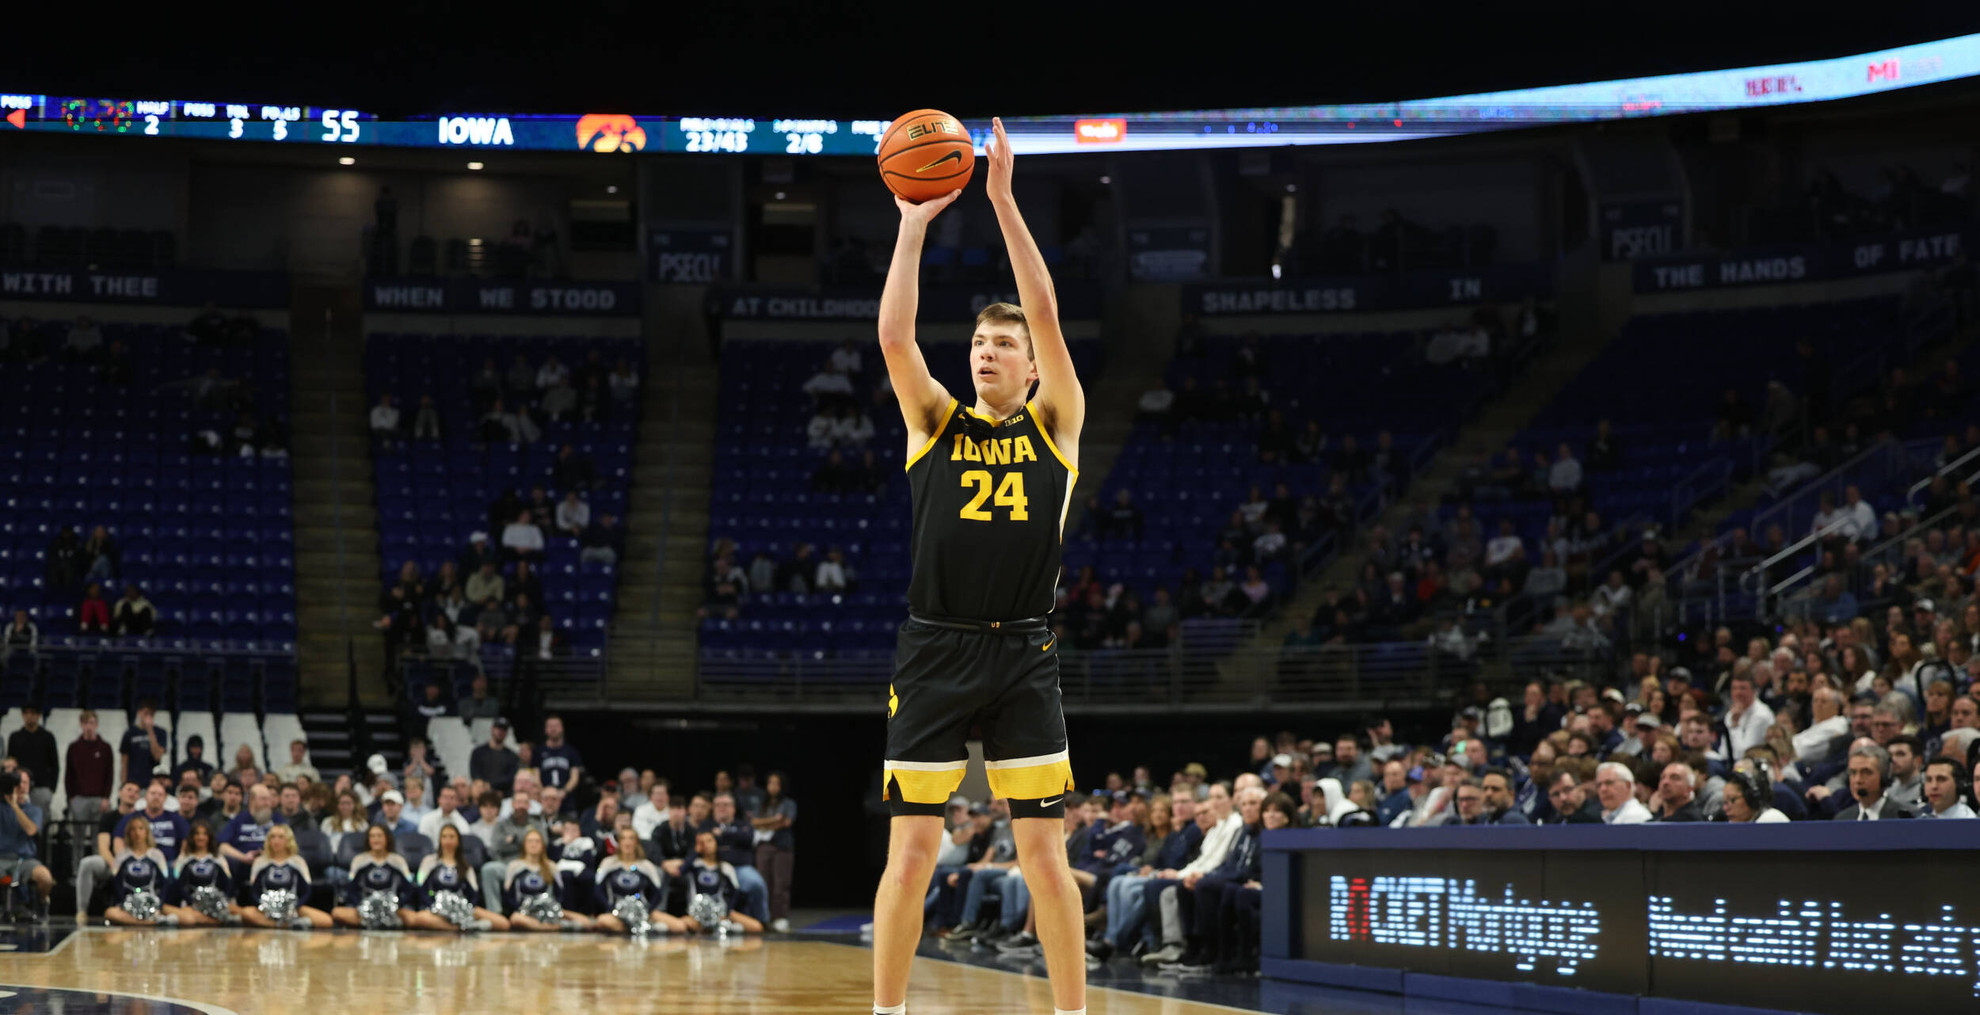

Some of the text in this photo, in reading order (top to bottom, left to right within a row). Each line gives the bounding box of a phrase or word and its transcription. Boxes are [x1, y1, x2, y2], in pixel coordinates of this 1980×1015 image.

[144, 114, 160, 136] 2
[228, 118, 244, 139] 3
[273, 119, 288, 141] 5
[321, 109, 361, 143] 55
[438, 116, 514, 145] IOWA
[906, 119, 960, 141] ELITE
[1655, 264, 1705, 289] THE
[1719, 256, 1807, 284] HANDS
[1853, 243, 1885, 269] OF
[2, 272, 159, 298] WITH THEE
[373, 286, 618, 311] WHEN WE STOOD
[1203, 278, 1482, 312] SHAPELESS IN
[732, 297, 880, 319] AT CHILDHOO
[951, 433, 1038, 465] IOWA
[959, 469, 1029, 522] 24
[1448, 878, 1600, 975] Mortgage
